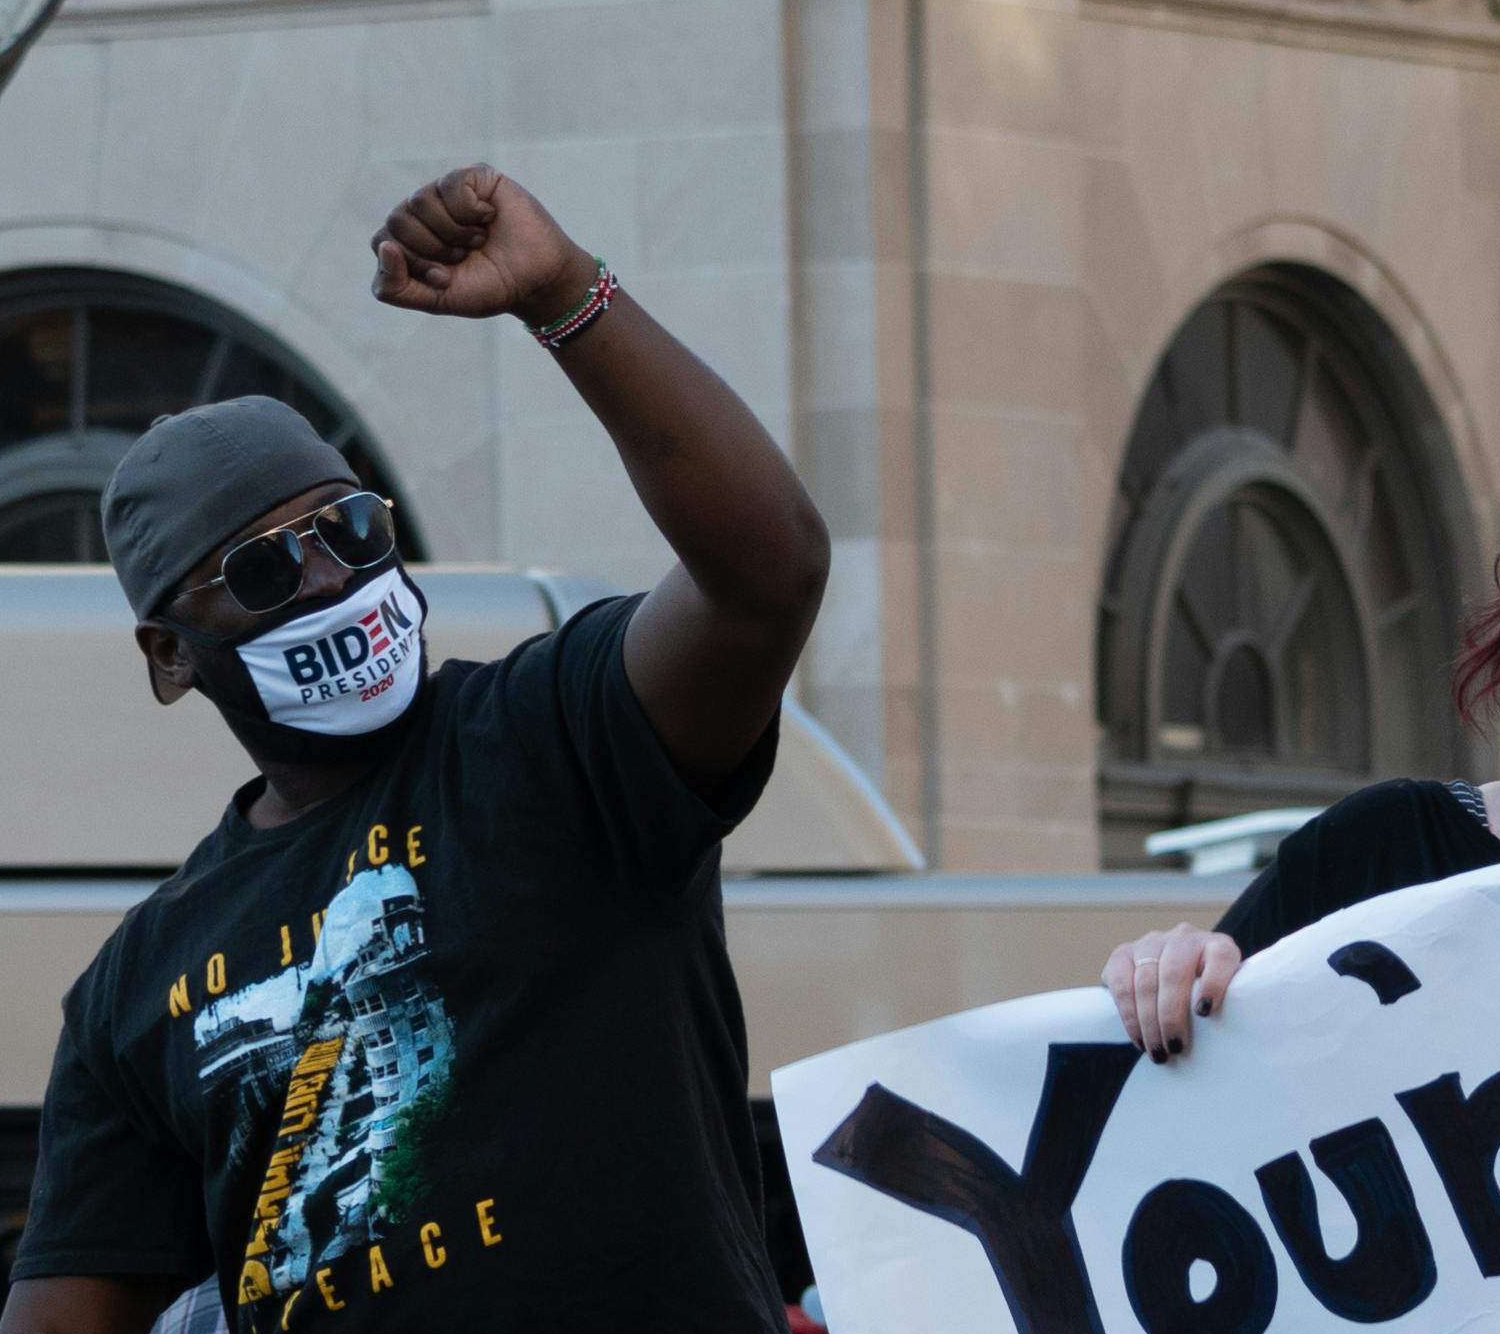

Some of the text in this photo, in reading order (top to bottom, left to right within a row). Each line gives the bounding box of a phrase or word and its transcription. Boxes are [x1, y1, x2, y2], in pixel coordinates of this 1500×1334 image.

[282, 591, 413, 686] BIDEN
[359, 673, 395, 703] 2020
[168, 952, 227, 1019] NO
